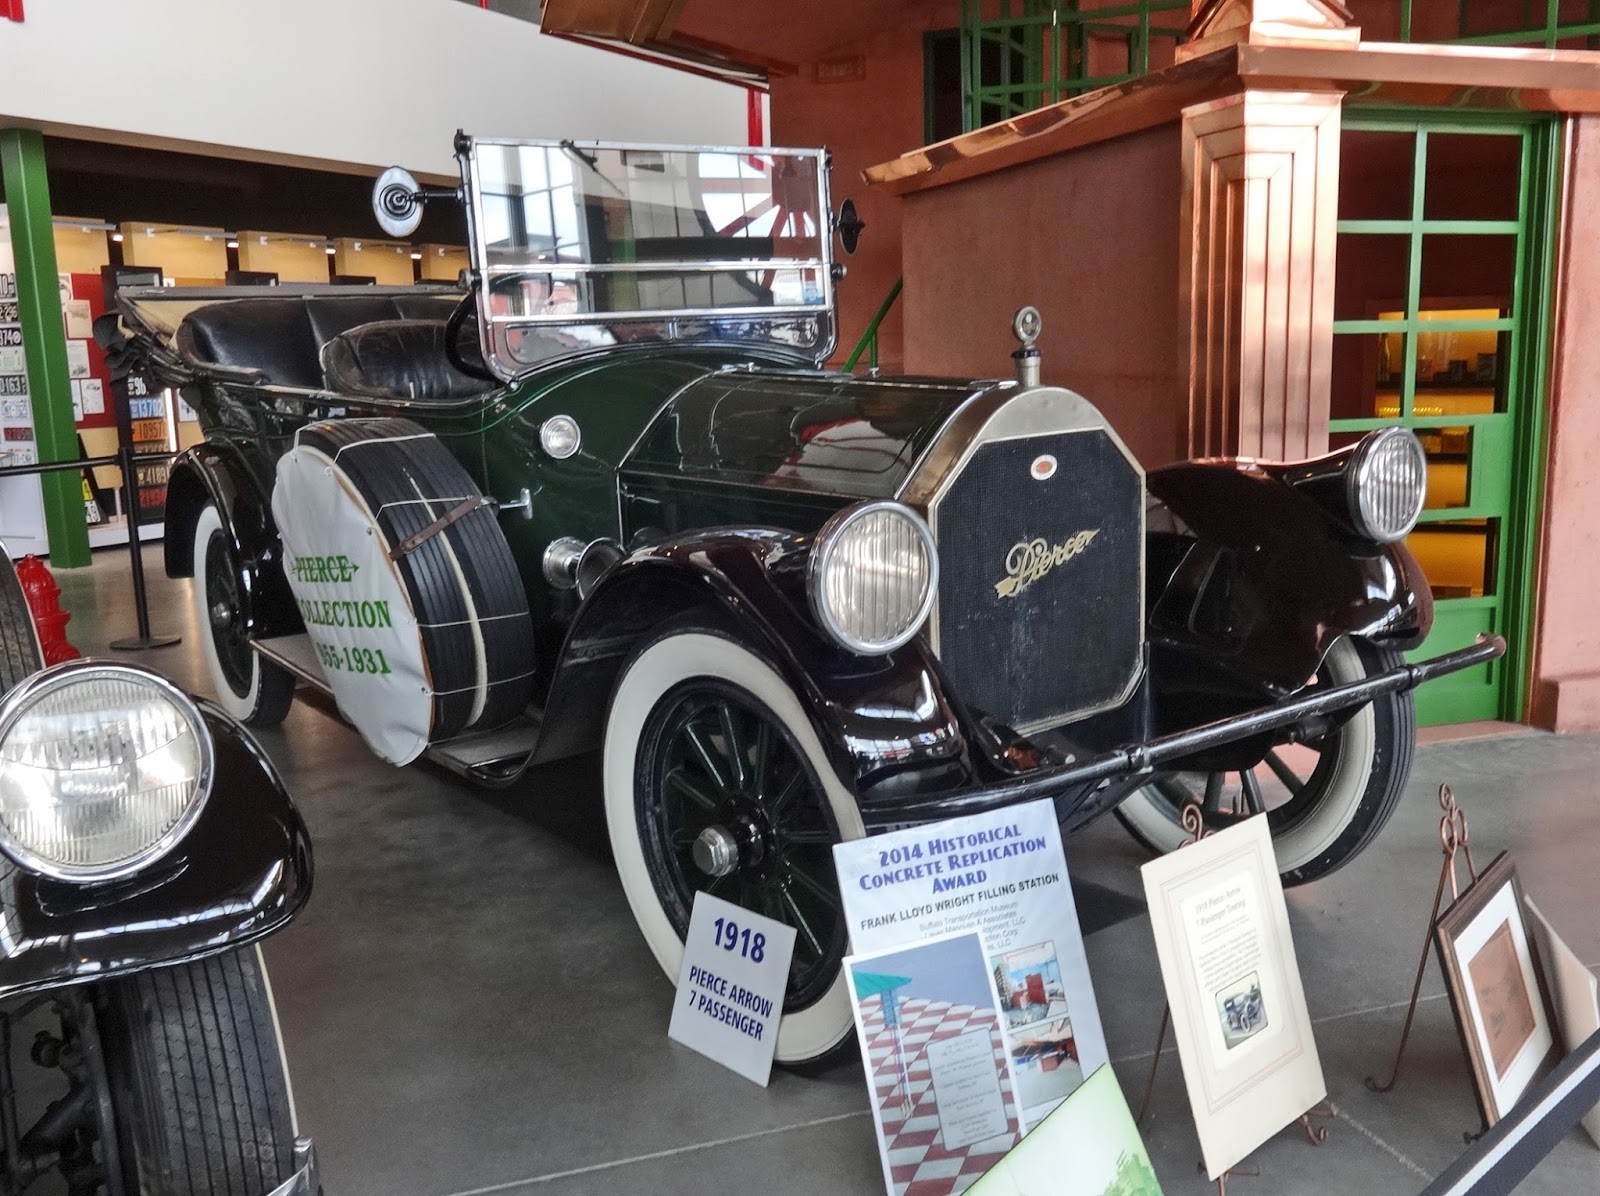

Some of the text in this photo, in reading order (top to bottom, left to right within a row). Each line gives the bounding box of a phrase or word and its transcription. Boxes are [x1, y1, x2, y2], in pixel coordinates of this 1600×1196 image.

[1003, 528, 1091, 598] Pierce
[300, 599, 392, 629] OLLECTION
[879, 844, 924, 868] 2014
[860, 872, 1060, 931] FRANK LLOYD WRIGHT FILLING STATION
[932, 869, 988, 895] AWARD
[714, 916, 766, 964] 1918
[688, 990, 764, 1041] 7 PASSENGER
[689, 965, 773, 1018] PIERCE ARROW
